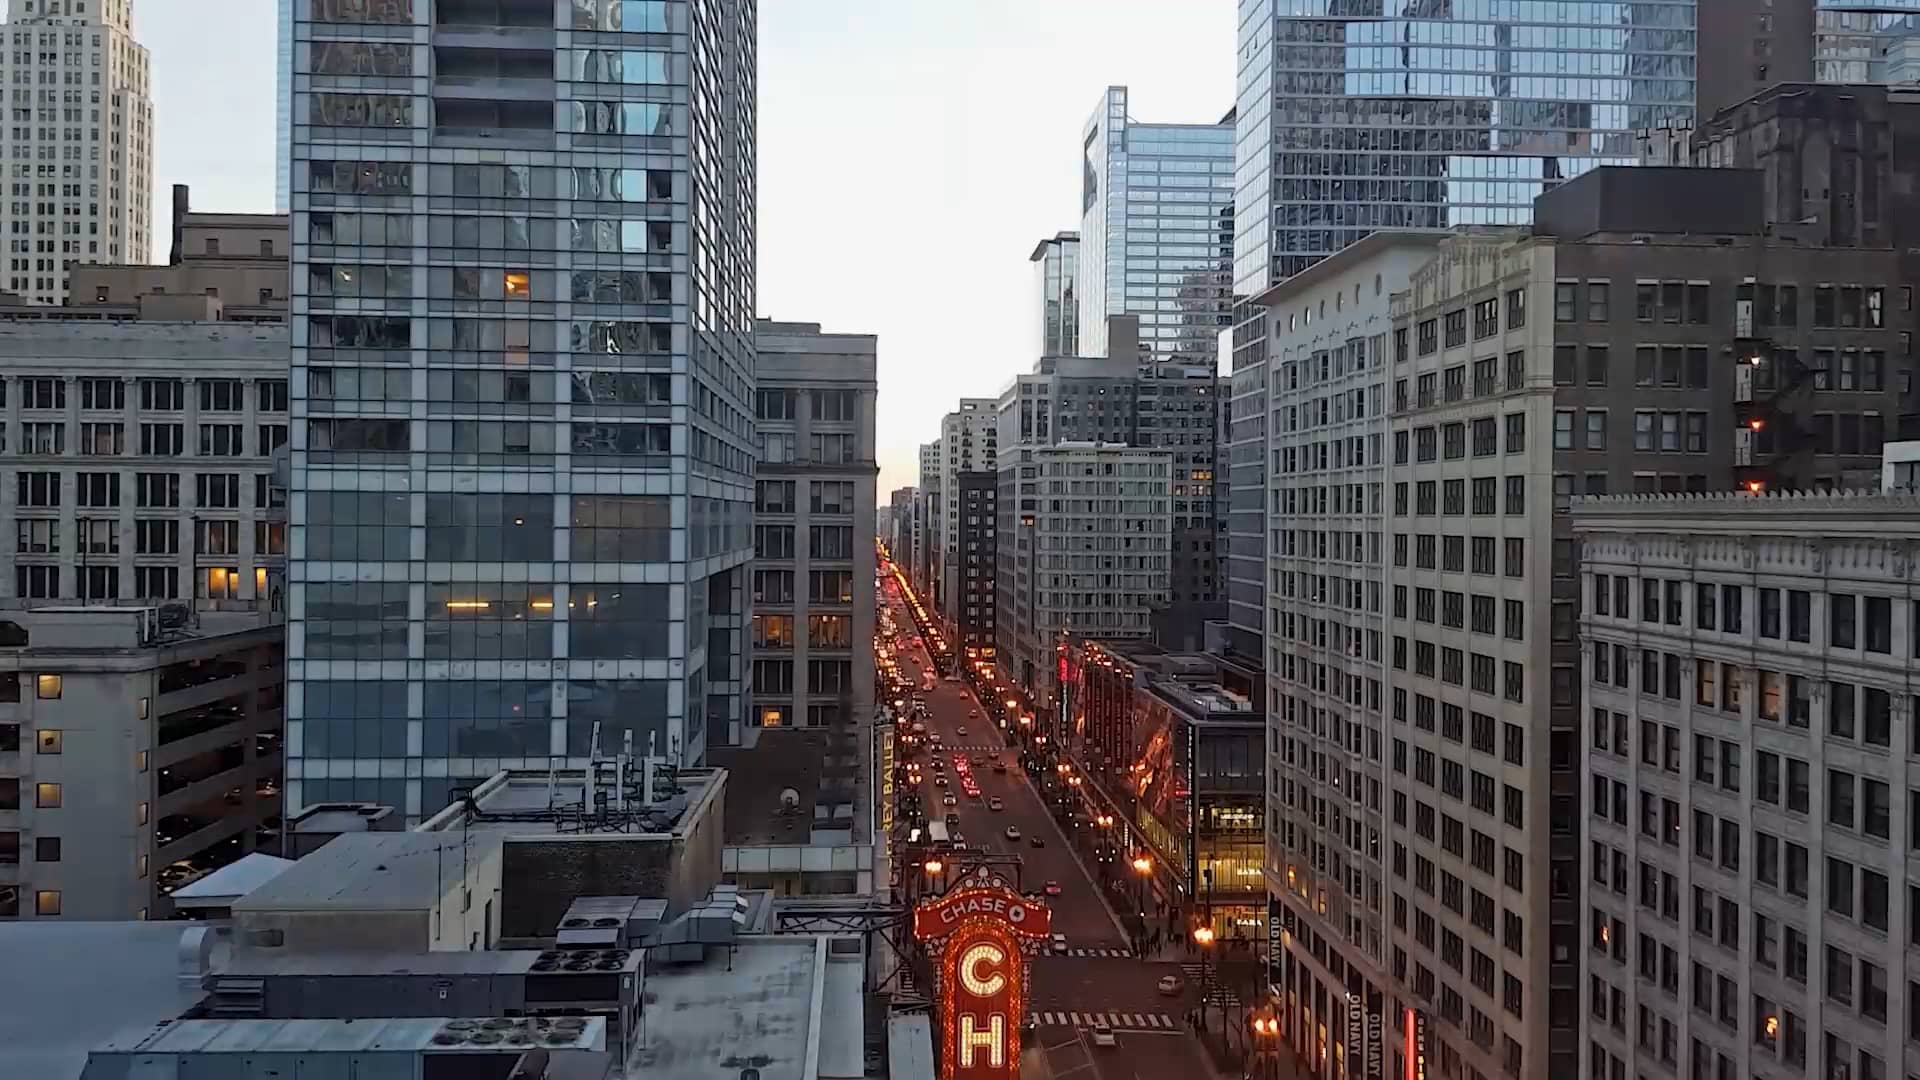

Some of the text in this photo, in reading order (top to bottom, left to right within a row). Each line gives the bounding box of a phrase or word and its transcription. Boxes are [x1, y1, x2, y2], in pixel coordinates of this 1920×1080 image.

[883, 732, 894, 796] BALLET
[940, 898, 1007, 923] CHASE
[1271, 917, 1280, 968] OLD NAVY
[1350, 995, 1361, 1056] OLD NAVY
[1369, 1013, 1380, 1076] OLD NAVY
